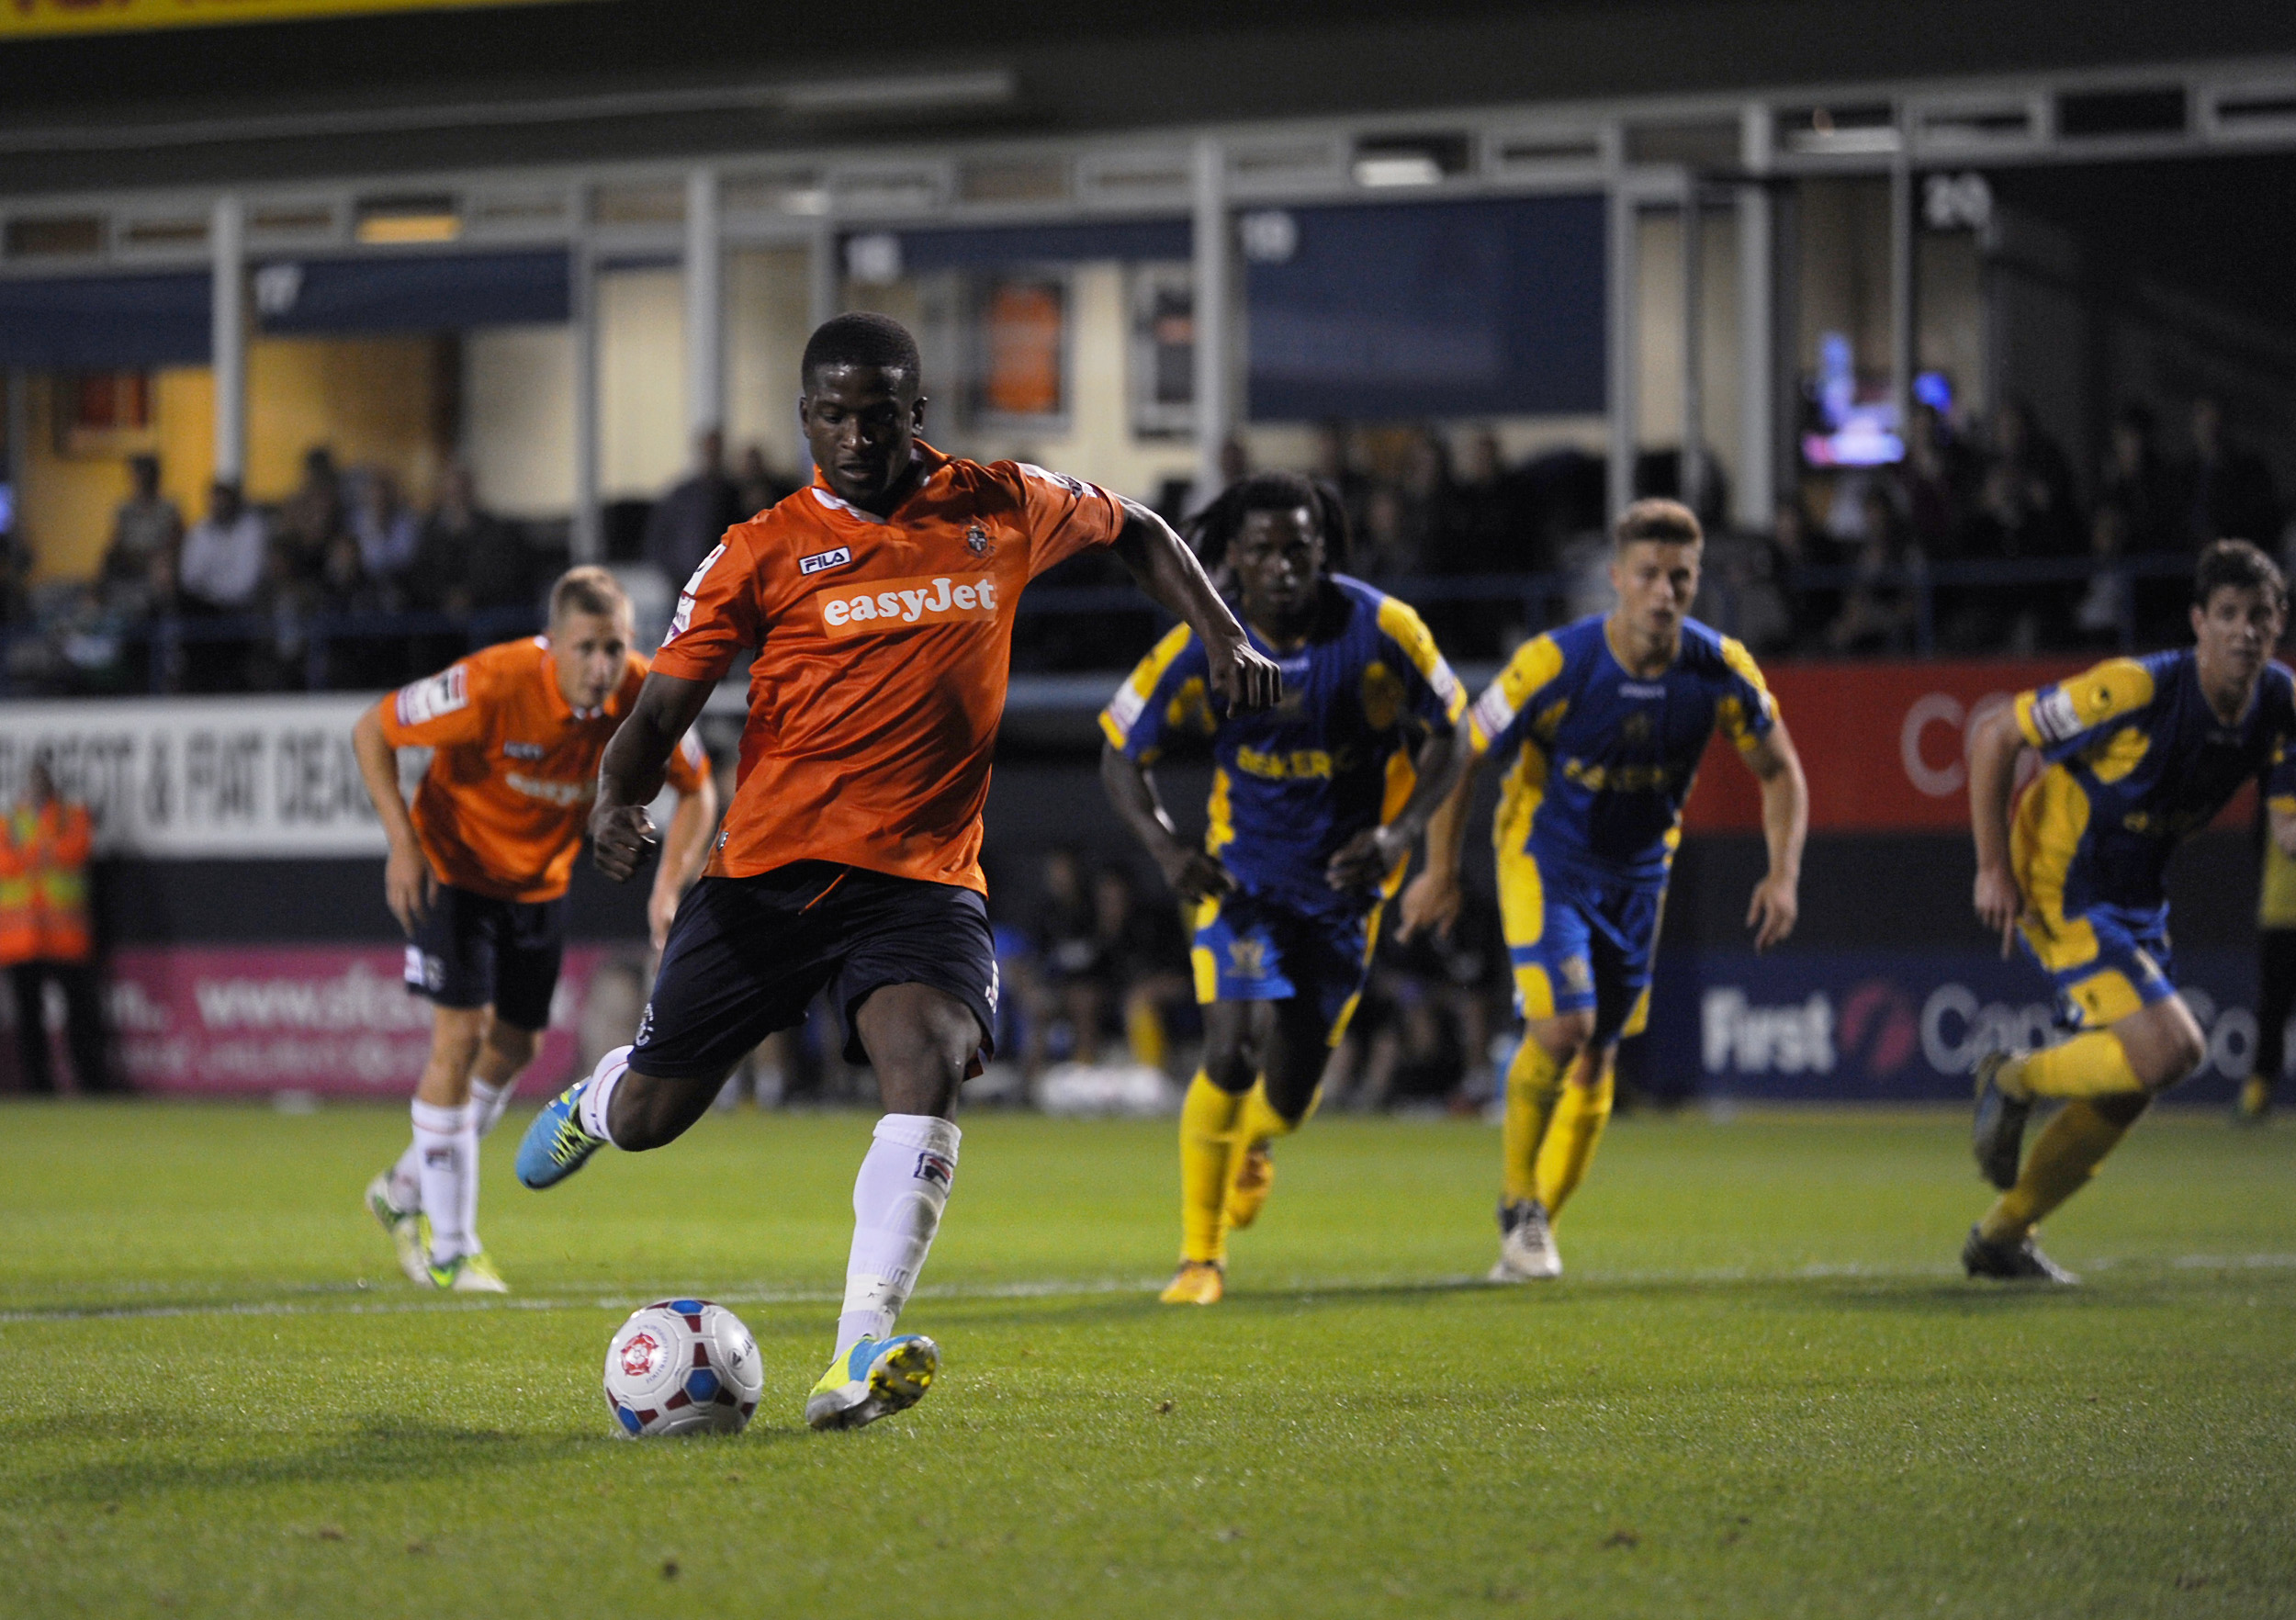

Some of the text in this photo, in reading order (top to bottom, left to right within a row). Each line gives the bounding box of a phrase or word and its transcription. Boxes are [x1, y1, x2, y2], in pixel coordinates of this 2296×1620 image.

[804, 551, 846, 572] FILA
[824, 577, 996, 626] easyJet
[276, 730, 377, 824] DEA
[1701, 986, 1835, 1075] First
